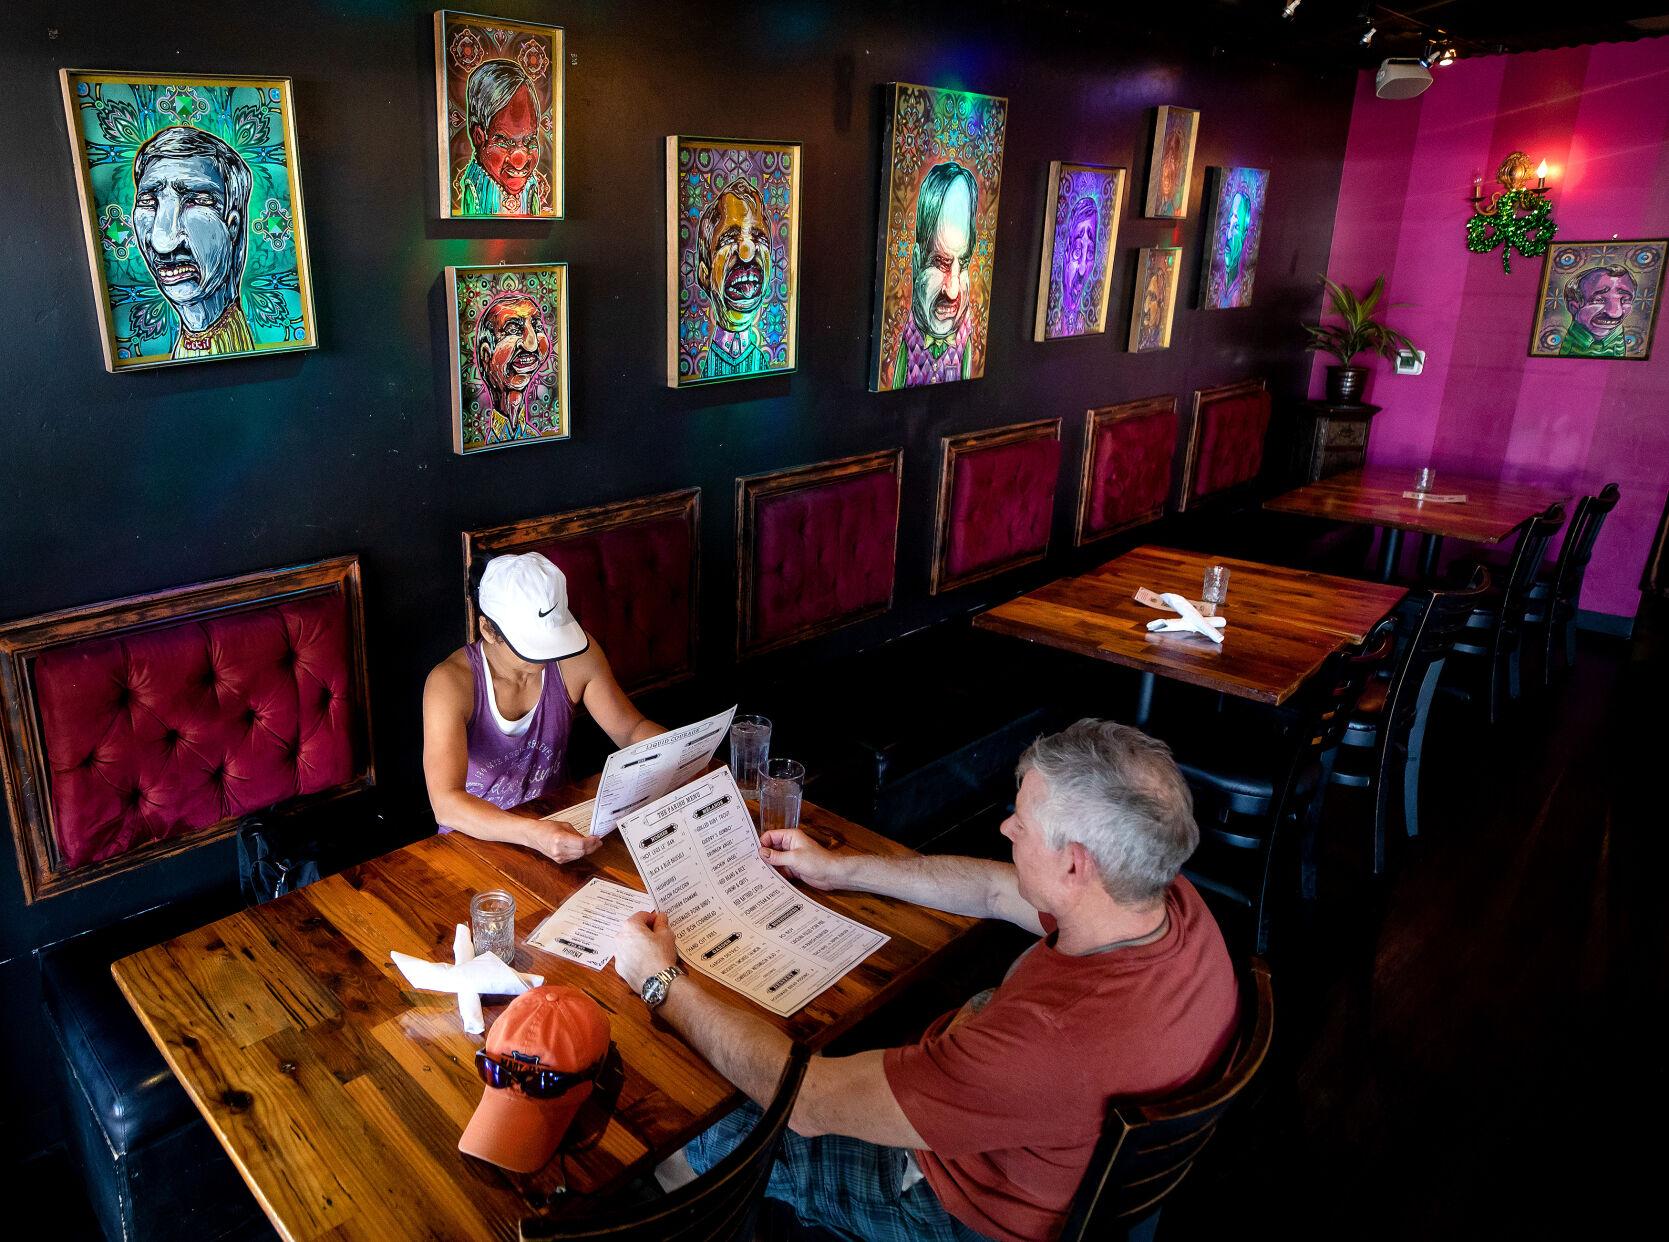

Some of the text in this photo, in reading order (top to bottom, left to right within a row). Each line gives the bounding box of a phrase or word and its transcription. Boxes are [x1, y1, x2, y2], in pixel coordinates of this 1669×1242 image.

[657, 808, 667, 818] THE
[667, 800, 686, 814] PARISH
[686, 792, 700, 806] MENU
[673, 882, 690, 895] POPCORN
[676, 930, 686, 939] CAST
[699, 937, 707, 946] CUT
[707, 930, 718, 940] FRIES
[712, 939, 732, 954] GARDEN
